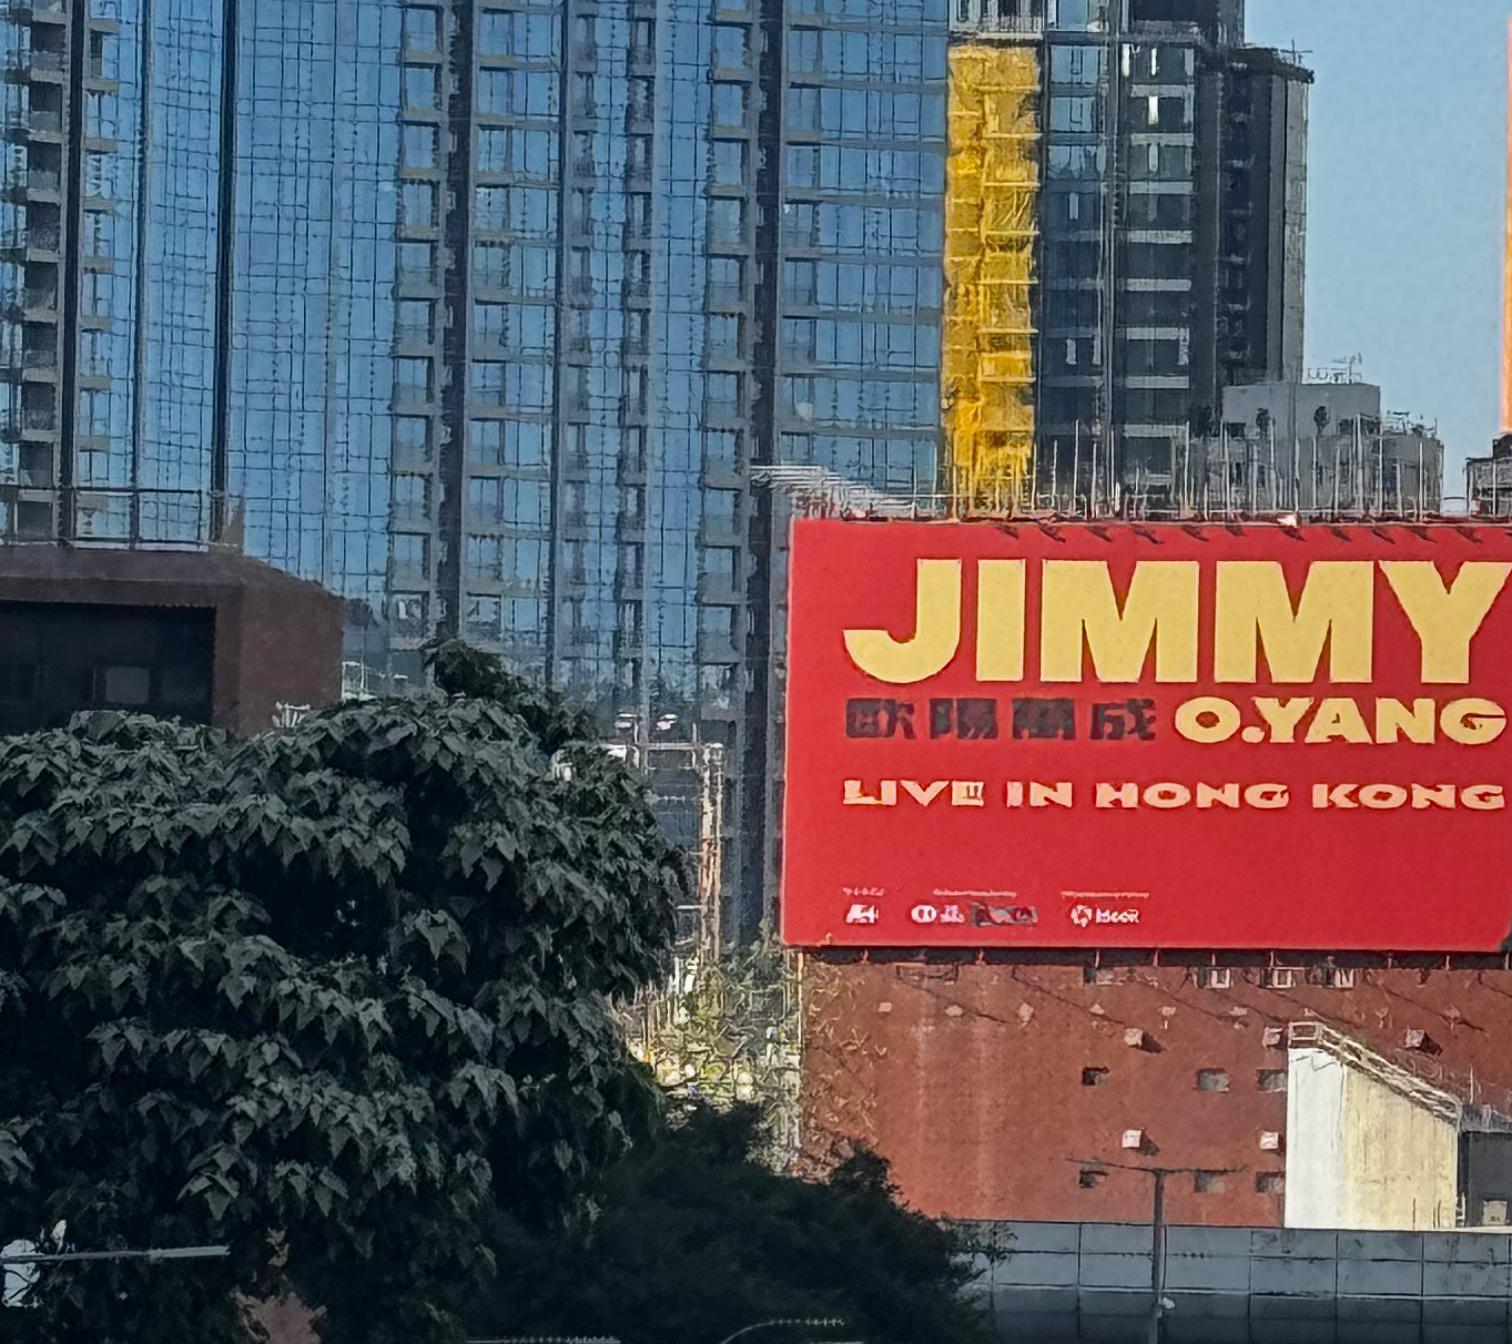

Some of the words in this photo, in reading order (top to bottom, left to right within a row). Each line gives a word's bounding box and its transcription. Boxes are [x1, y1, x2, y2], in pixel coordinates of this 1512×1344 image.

[1174, 696, 1507, 745] O.YANG
[842, 779, 985, 808] LIVE
[1006, 781, 1073, 808] IN
[1096, 781, 1290, 810] HONG
[1312, 782, 1506, 810] KONG
